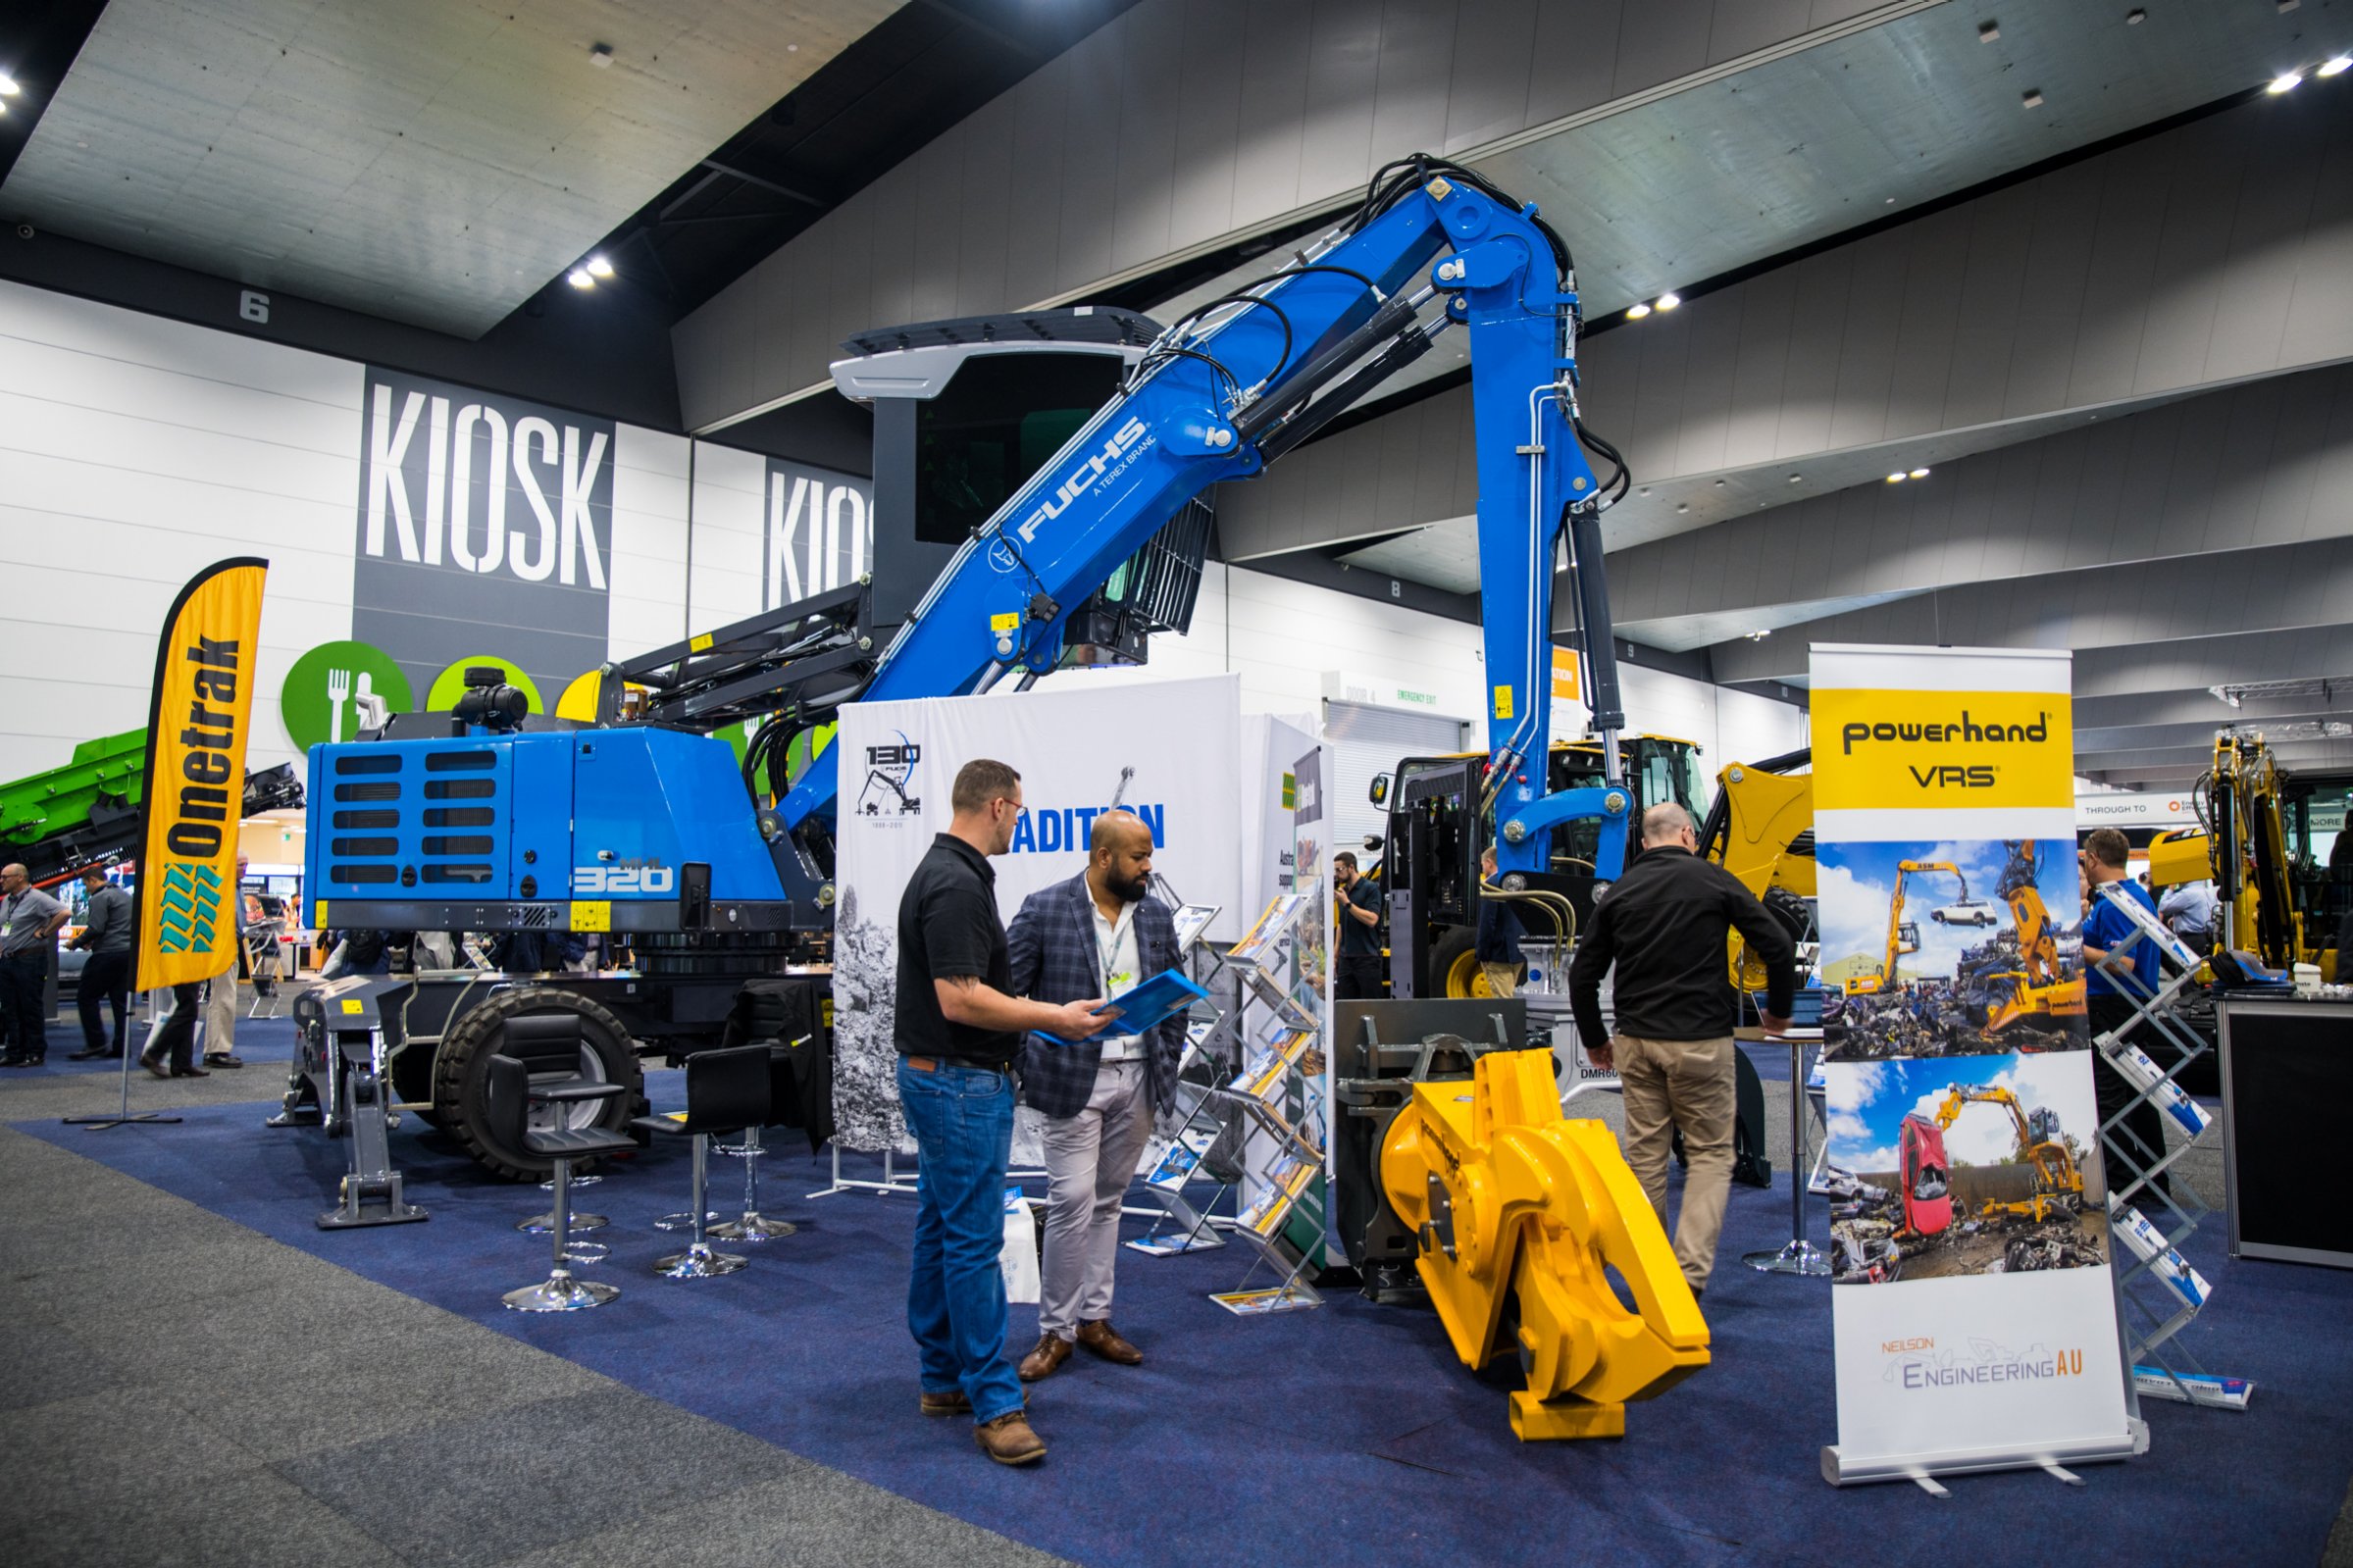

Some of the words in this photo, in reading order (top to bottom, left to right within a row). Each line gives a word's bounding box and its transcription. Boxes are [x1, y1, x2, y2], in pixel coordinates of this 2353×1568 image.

[239, 289, 270, 325] 6
[366, 383, 609, 590] KIOSK
[1017, 416, 1147, 544] FUCHS
[1093, 487, 1101, 497] A
[1100, 461, 1128, 489] TEREX
[767, 472, 874, 611] KIO
[1391, 581, 1401, 597] 8
[1627, 643, 1634, 658] 9
[1551, 667, 1573, 683] ATION
[1397, 689, 1425, 703] EMERGENCY
[1426, 693, 1437, 705] EXIT
[1843, 710, 2047, 755] powerhand
[866, 744, 920, 765] 130
[1909, 765, 1995, 787] VRS
[2085, 806, 2130, 815] THROUGH
[2133, 805, 2147, 814] TO
[1011, 804, 1164, 853] ADITN
[2311, 818, 2341, 827] MORE
[1279, 849, 1294, 866] Austra
[575, 866, 673, 892] 320
[1881, 1337, 1935, 1353] NEILSON
